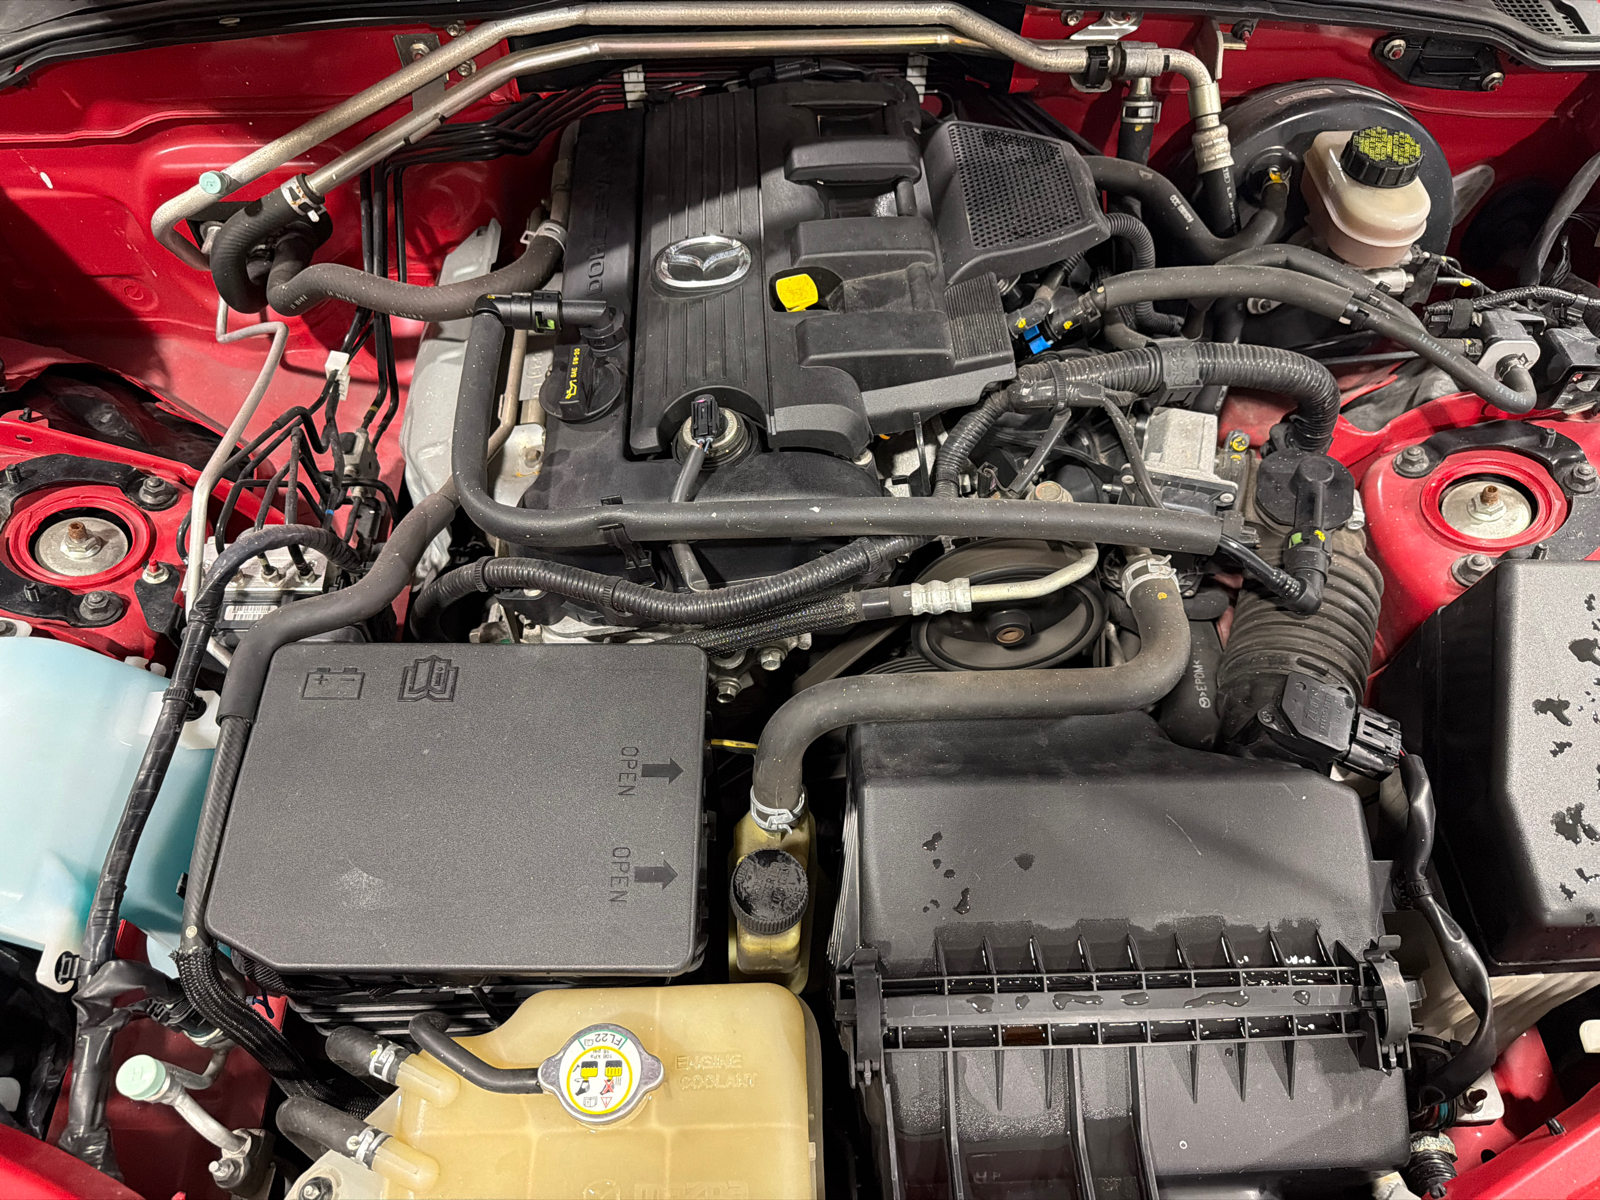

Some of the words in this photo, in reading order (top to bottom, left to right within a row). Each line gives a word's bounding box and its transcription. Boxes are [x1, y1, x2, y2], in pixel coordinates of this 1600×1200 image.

[572, 348, 580, 365] 5W-20
[618, 746, 639, 796] OPEN
[609, 846, 631, 903] OPEN
[594, 1033, 622, 1046] FL22
[676, 1054, 742, 1070] ENGINE
[680, 1072, 758, 1089] COOLANT
